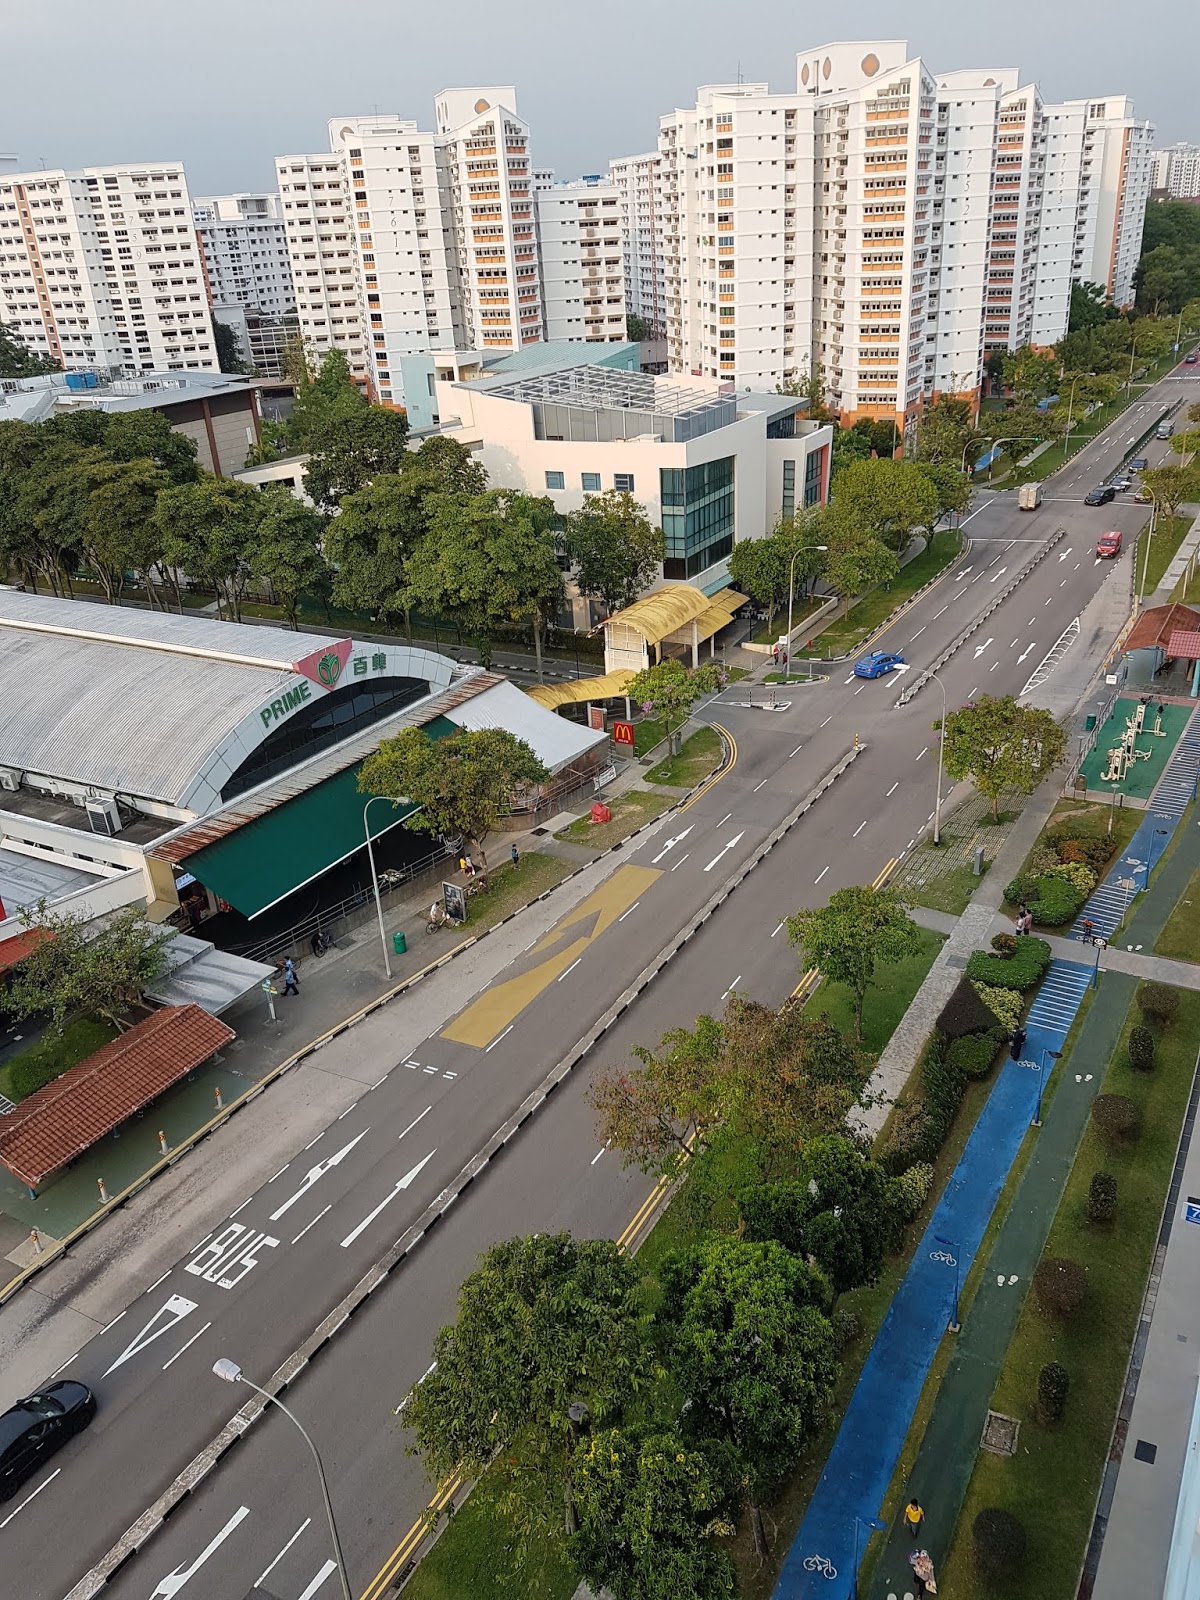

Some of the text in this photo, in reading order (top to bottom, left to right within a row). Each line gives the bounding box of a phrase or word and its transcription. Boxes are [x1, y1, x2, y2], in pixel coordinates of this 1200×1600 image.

[962, 156, 973, 216] 752
[129, 215, 142, 260] 759
[388, 196, 398, 248] 761
[259, 680, 312, 729] PRIME
[183, 1222, 281, 1290] BUS
